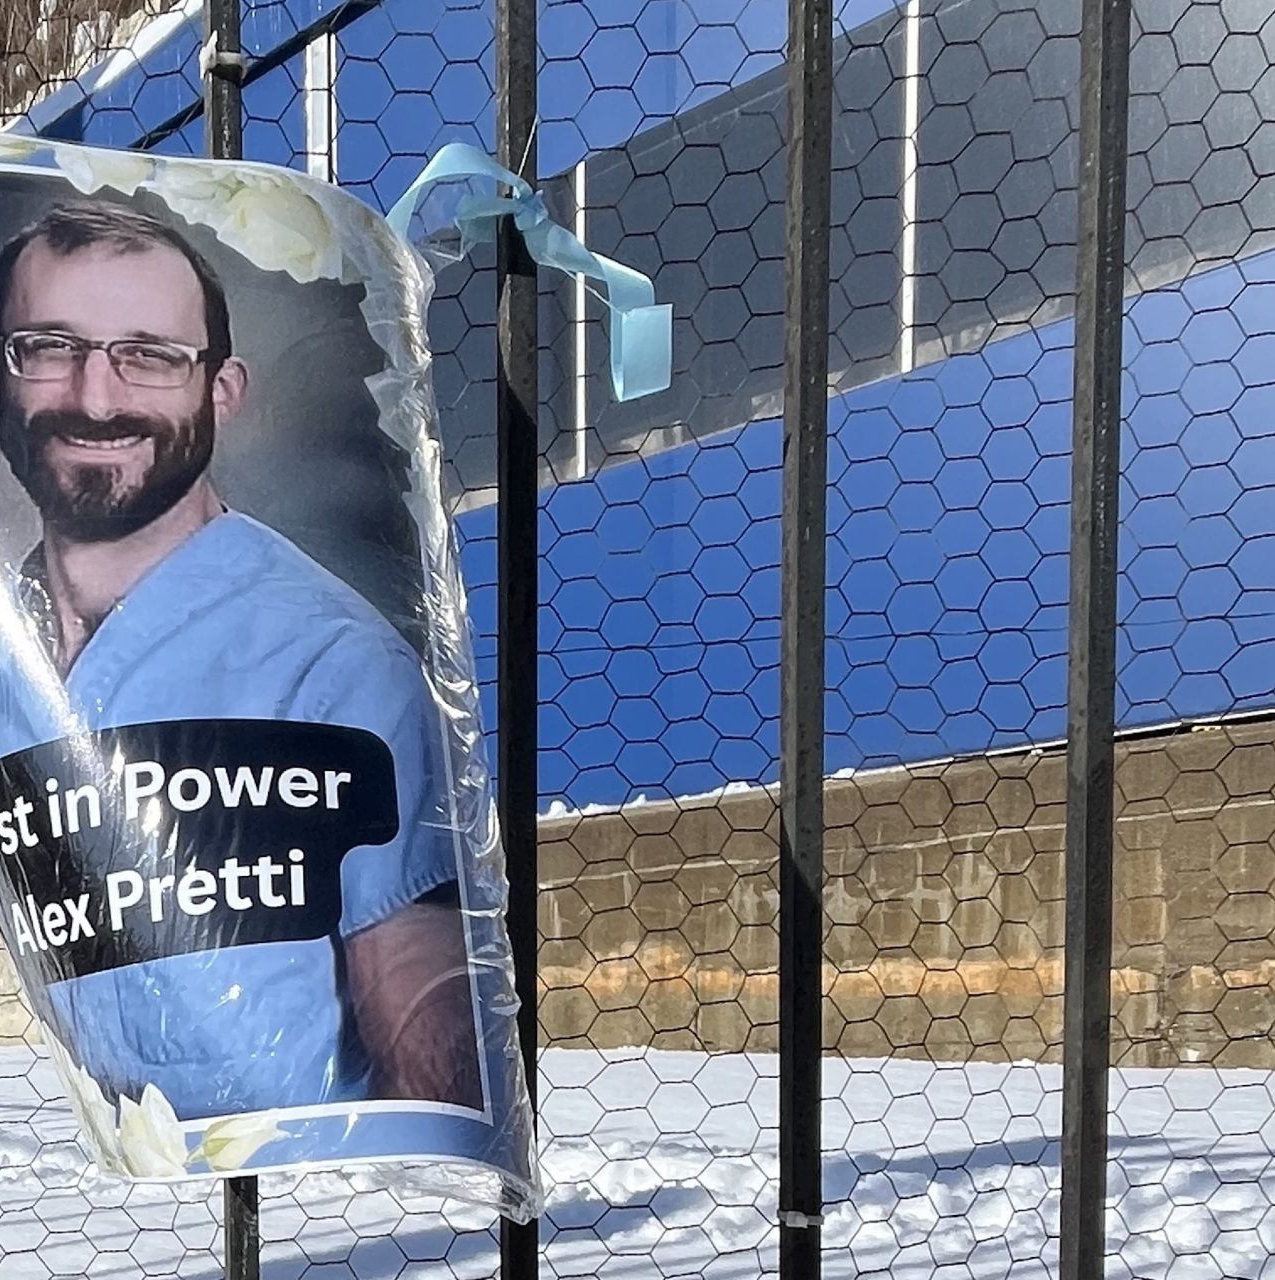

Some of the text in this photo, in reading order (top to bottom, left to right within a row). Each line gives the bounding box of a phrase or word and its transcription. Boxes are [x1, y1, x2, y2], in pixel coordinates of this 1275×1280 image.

[46, 777, 102, 839] in
[124, 760, 353, 822] Power
[9, 848, 306, 957] Alex Pretti
